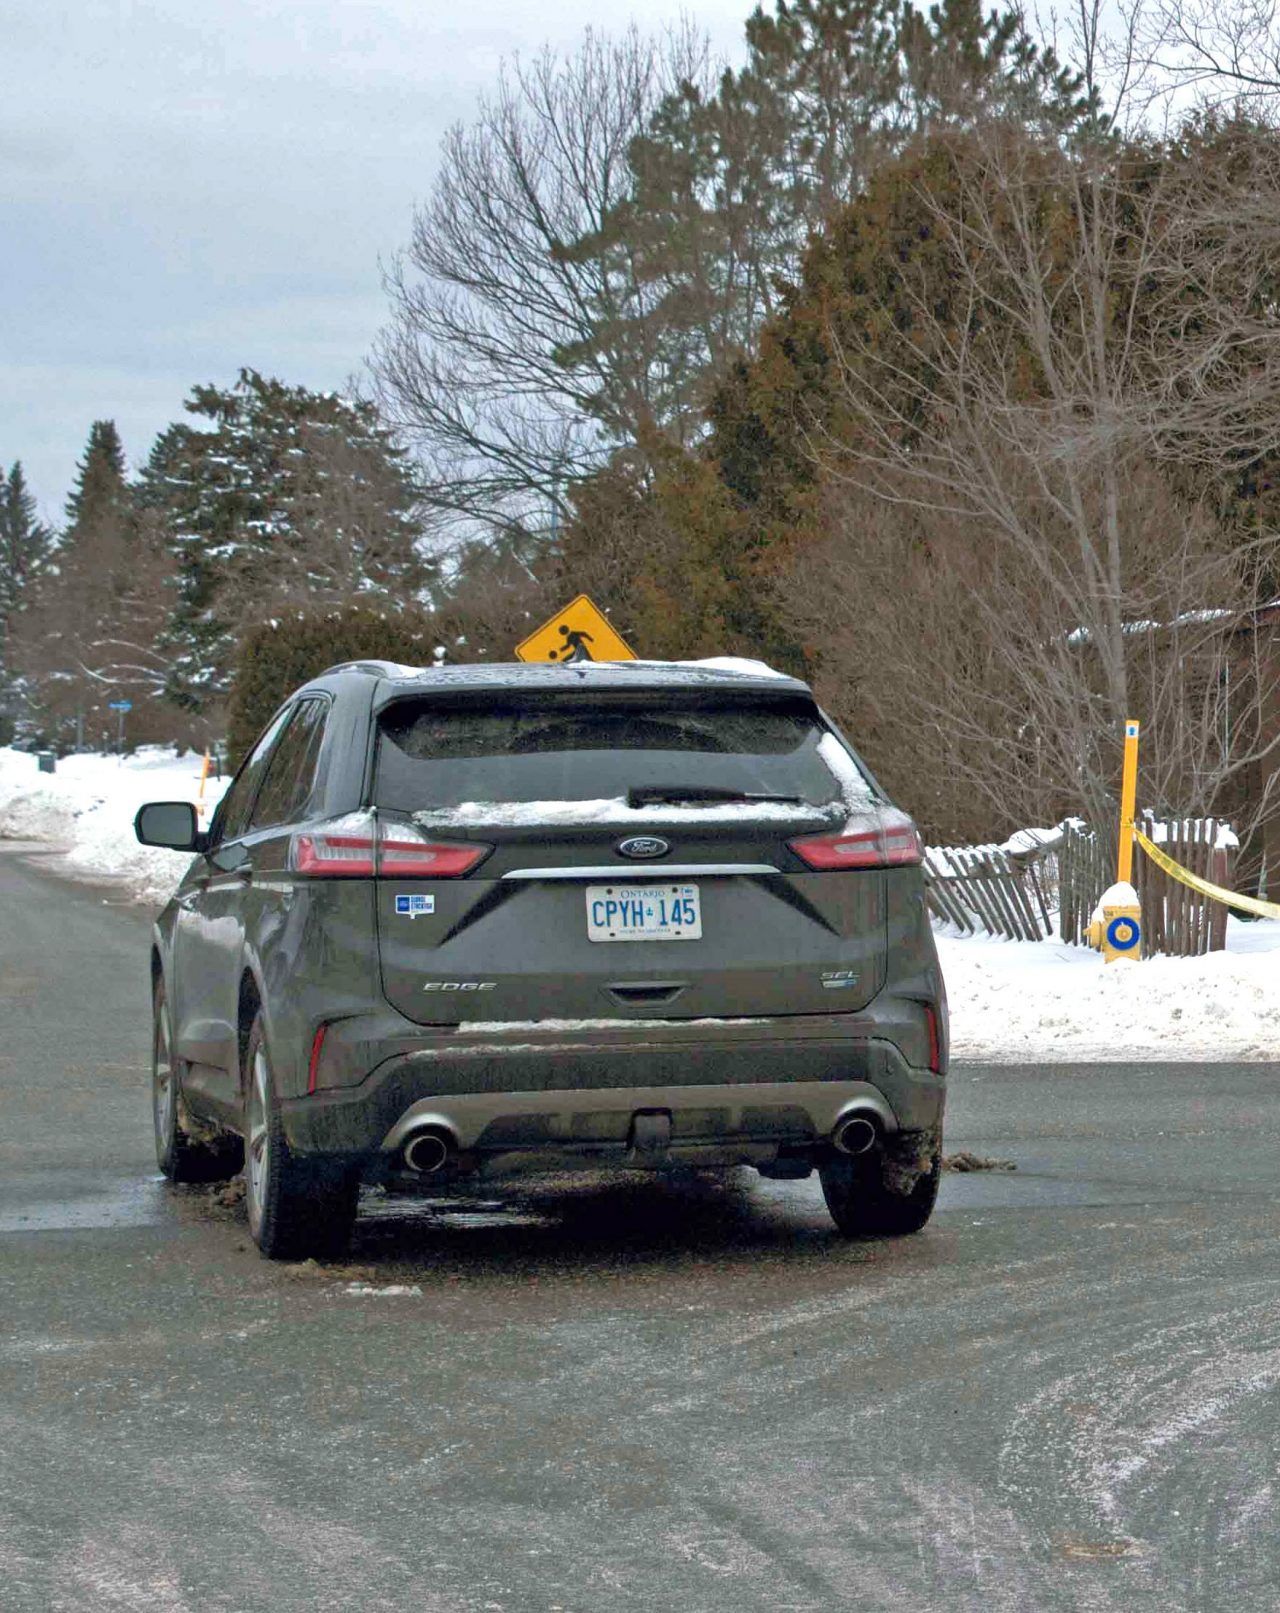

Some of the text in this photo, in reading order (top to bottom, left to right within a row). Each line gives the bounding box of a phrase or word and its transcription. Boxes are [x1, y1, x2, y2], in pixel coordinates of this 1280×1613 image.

[620, 889, 665, 899] ONTARIO
[592, 899, 695, 927] CPYH 145
[820, 971, 860, 979] SEL
[423, 982, 498, 991] EDGE
